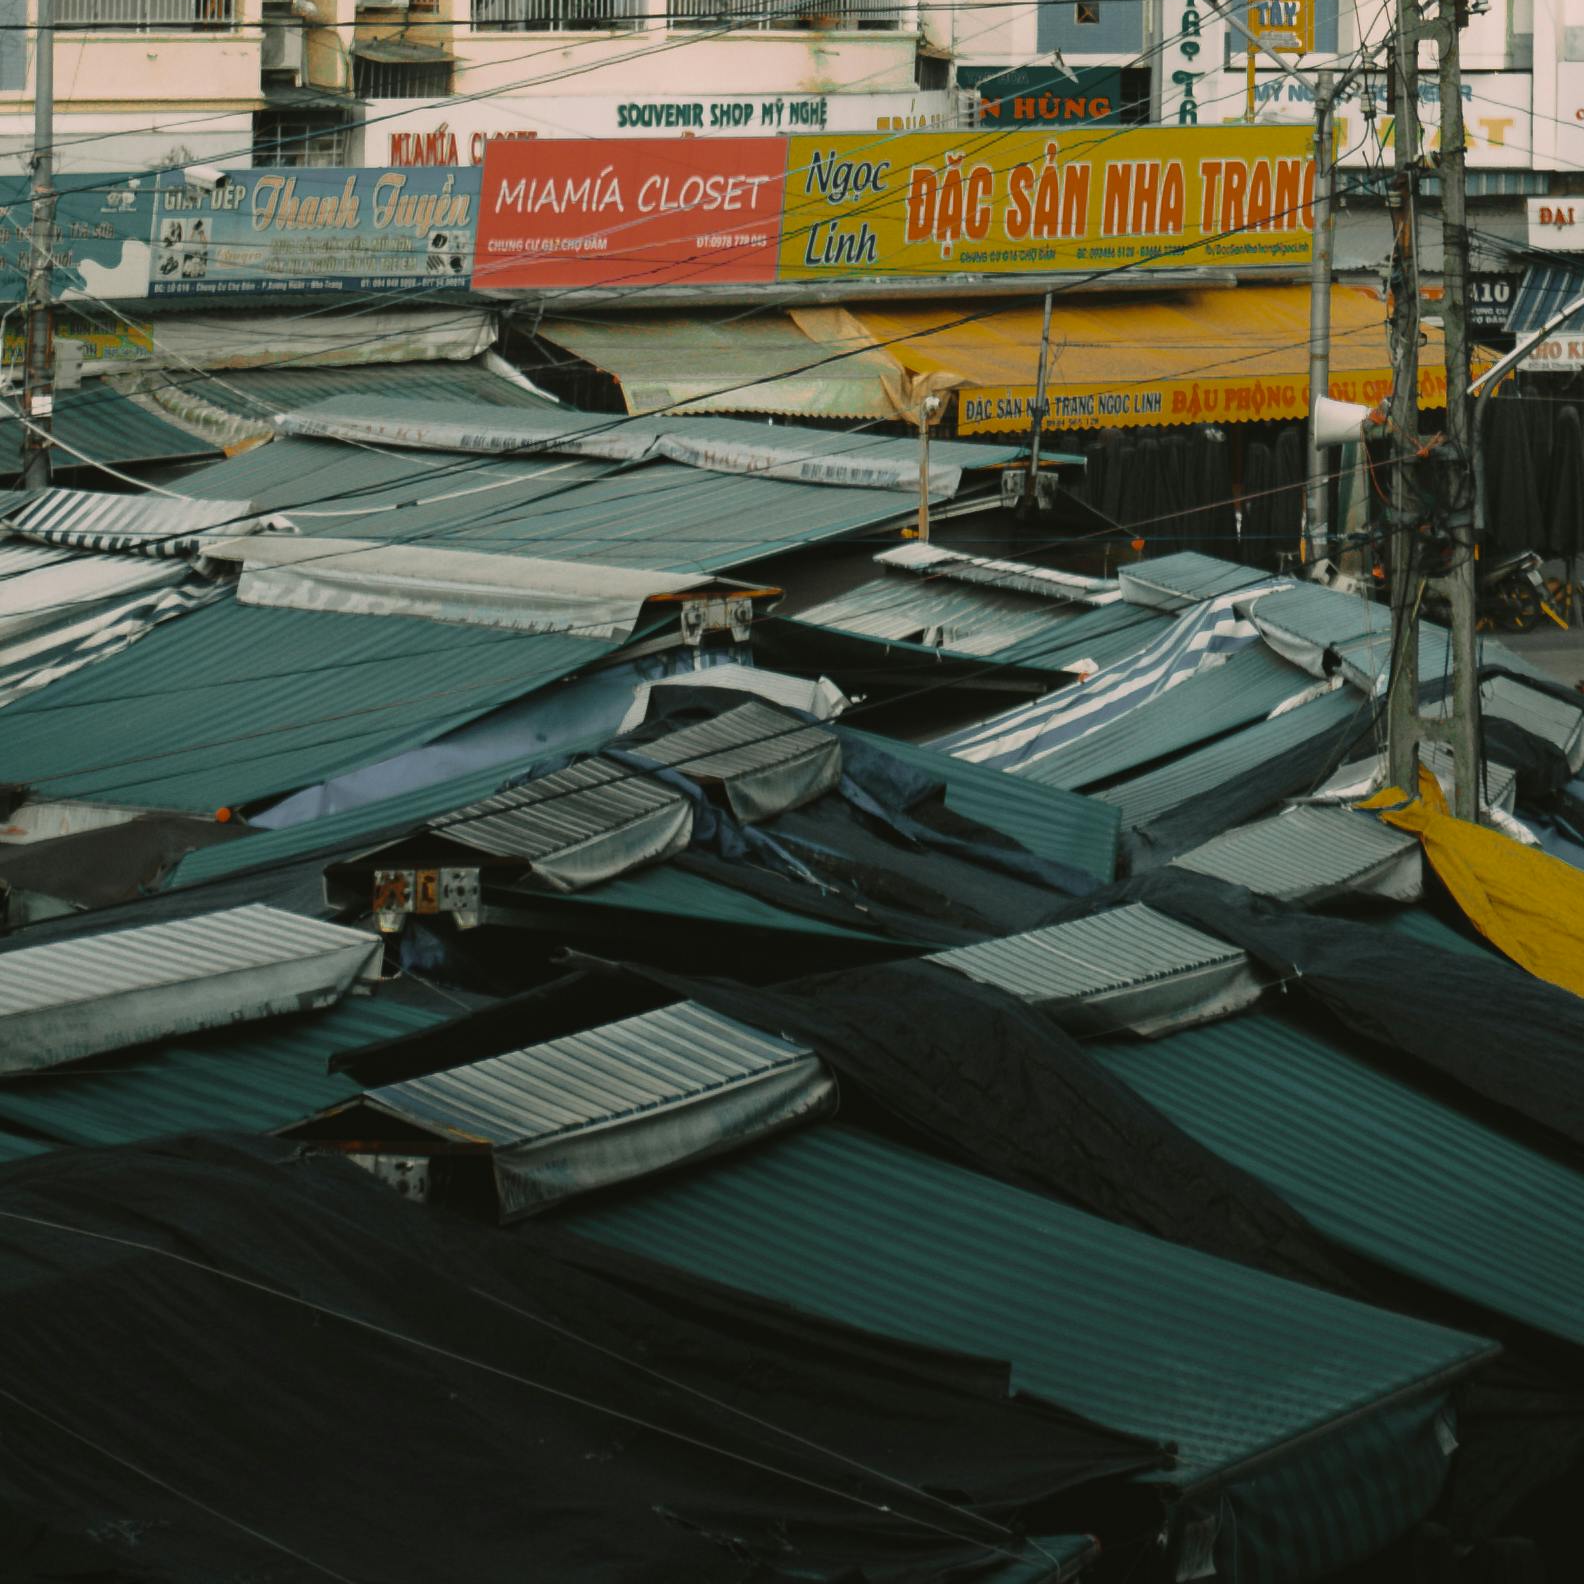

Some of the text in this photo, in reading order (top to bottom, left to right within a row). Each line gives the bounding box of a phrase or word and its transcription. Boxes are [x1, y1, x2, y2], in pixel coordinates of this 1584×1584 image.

[617, 102, 704, 129] SOUVENIR
[709, 102, 754, 128] SHOP
[1014, 91, 1112, 120] HÙNG
[252, 174, 361, 232] Thanh
[494, 164, 770, 214] MIAMÍA CLOSET
[804, 149, 890, 265] Ngọc Linh
[905, 151, 994, 259] ĐẶC
[1005, 140, 1092, 240] SẢN
[1102, 158, 1186, 237] NHA
[1539, 206, 1575, 230] ĐẠI
[966, 388, 1162, 426] ĐẶC SẢN NA TRANG NGỌC LINH
[1223, 379, 1297, 417] PHỘNG
